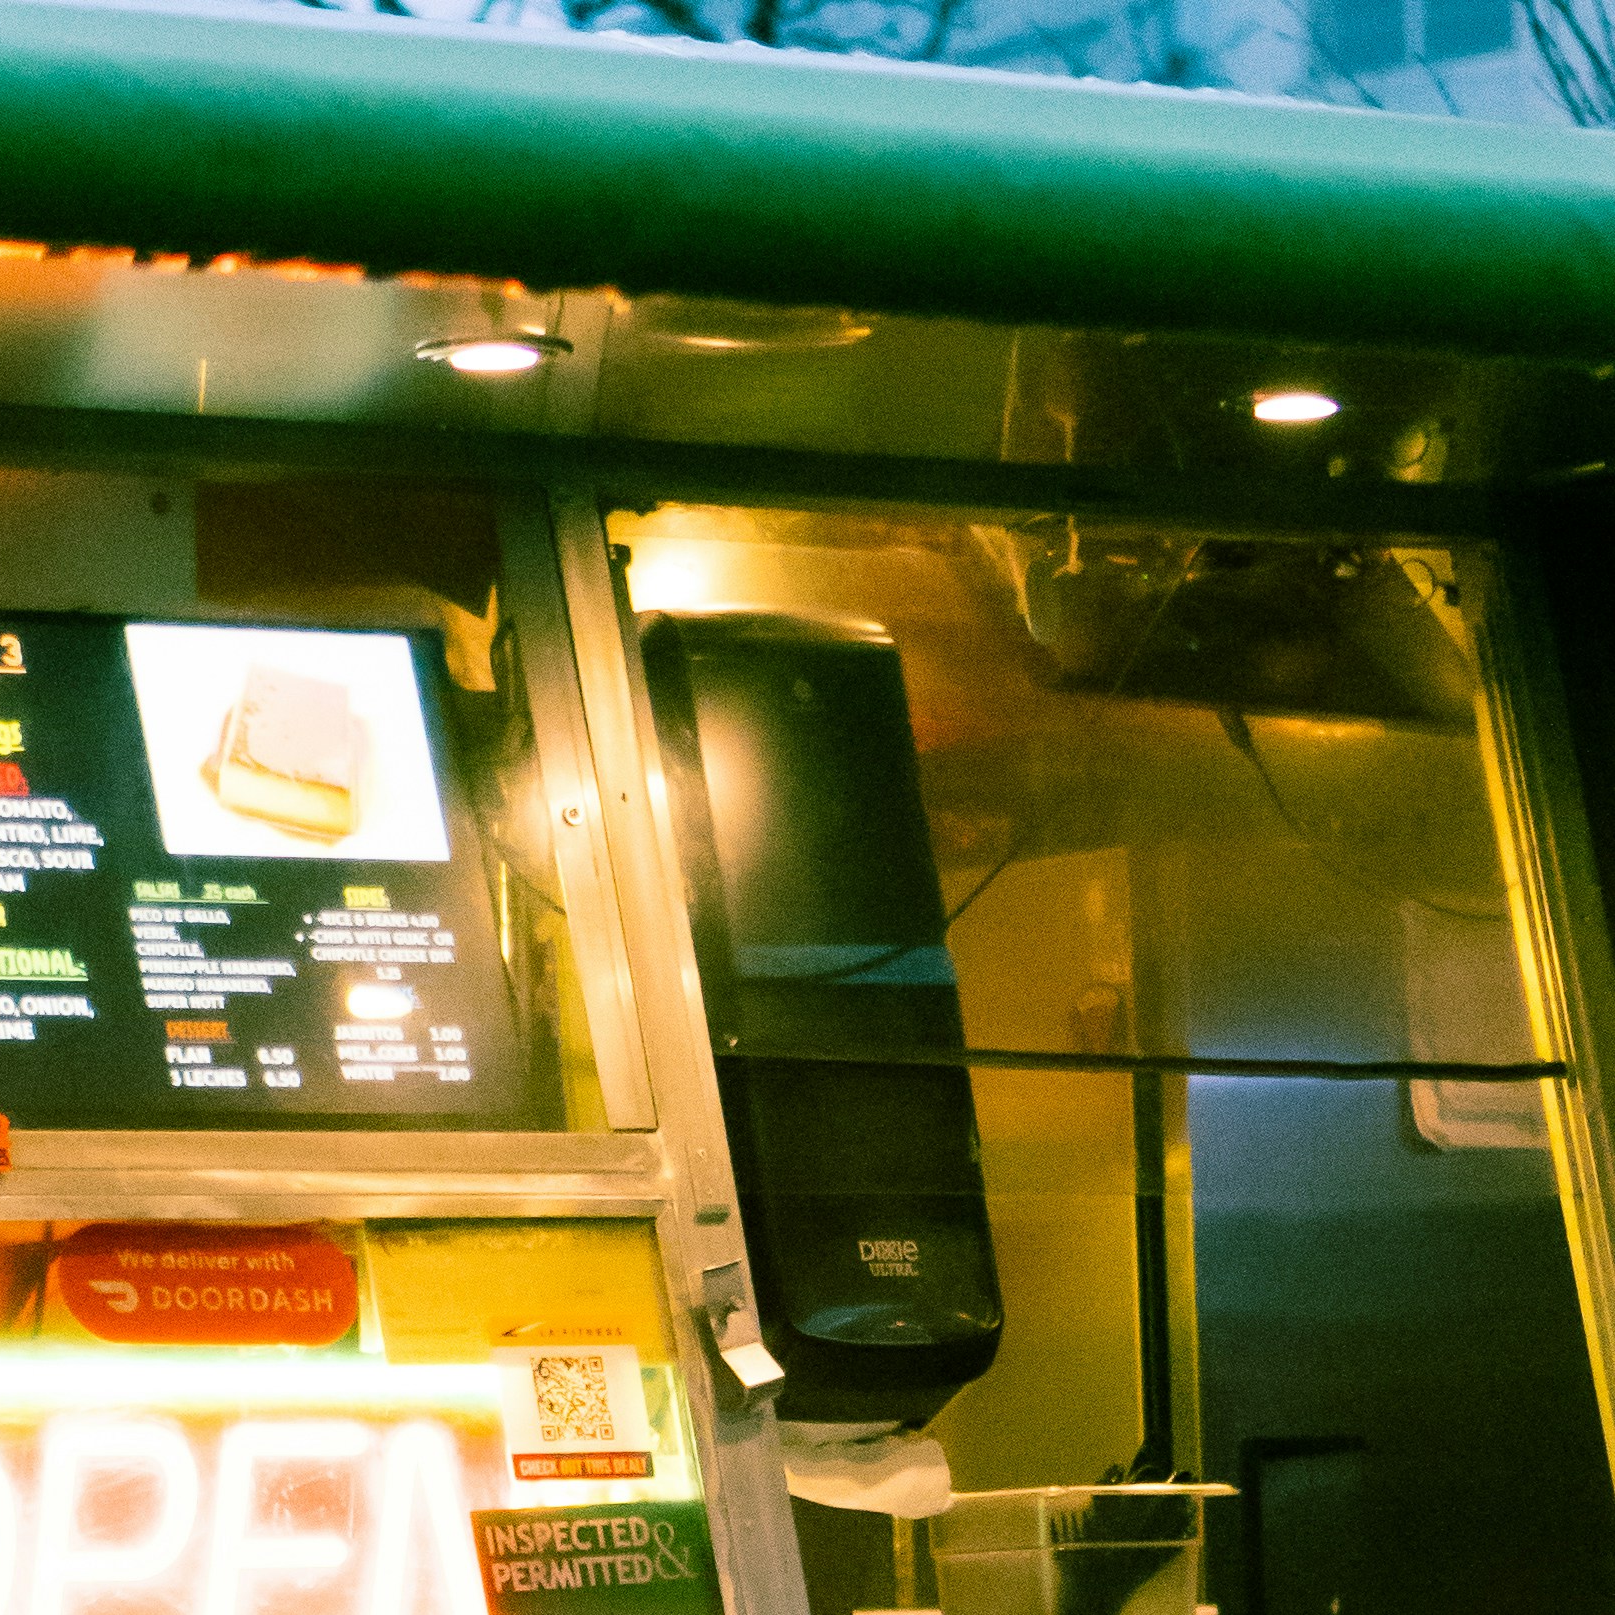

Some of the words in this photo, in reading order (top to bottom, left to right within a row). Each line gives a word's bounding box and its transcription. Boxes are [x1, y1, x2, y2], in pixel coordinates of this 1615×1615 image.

[41, 849, 96, 870] SOUR
[117, 1249, 155, 1269] We
[161, 1252, 240, 1270] deliver
[246, 1252, 295, 1272] with
[151, 1285, 333, 1313] DOORDASH
[518, 1458, 560, 1477] CHECK
[484, 1516, 650, 1557] INSPECTED
[652, 1520, 699, 1582] &
[492, 1553, 655, 1594] PERMITTED
